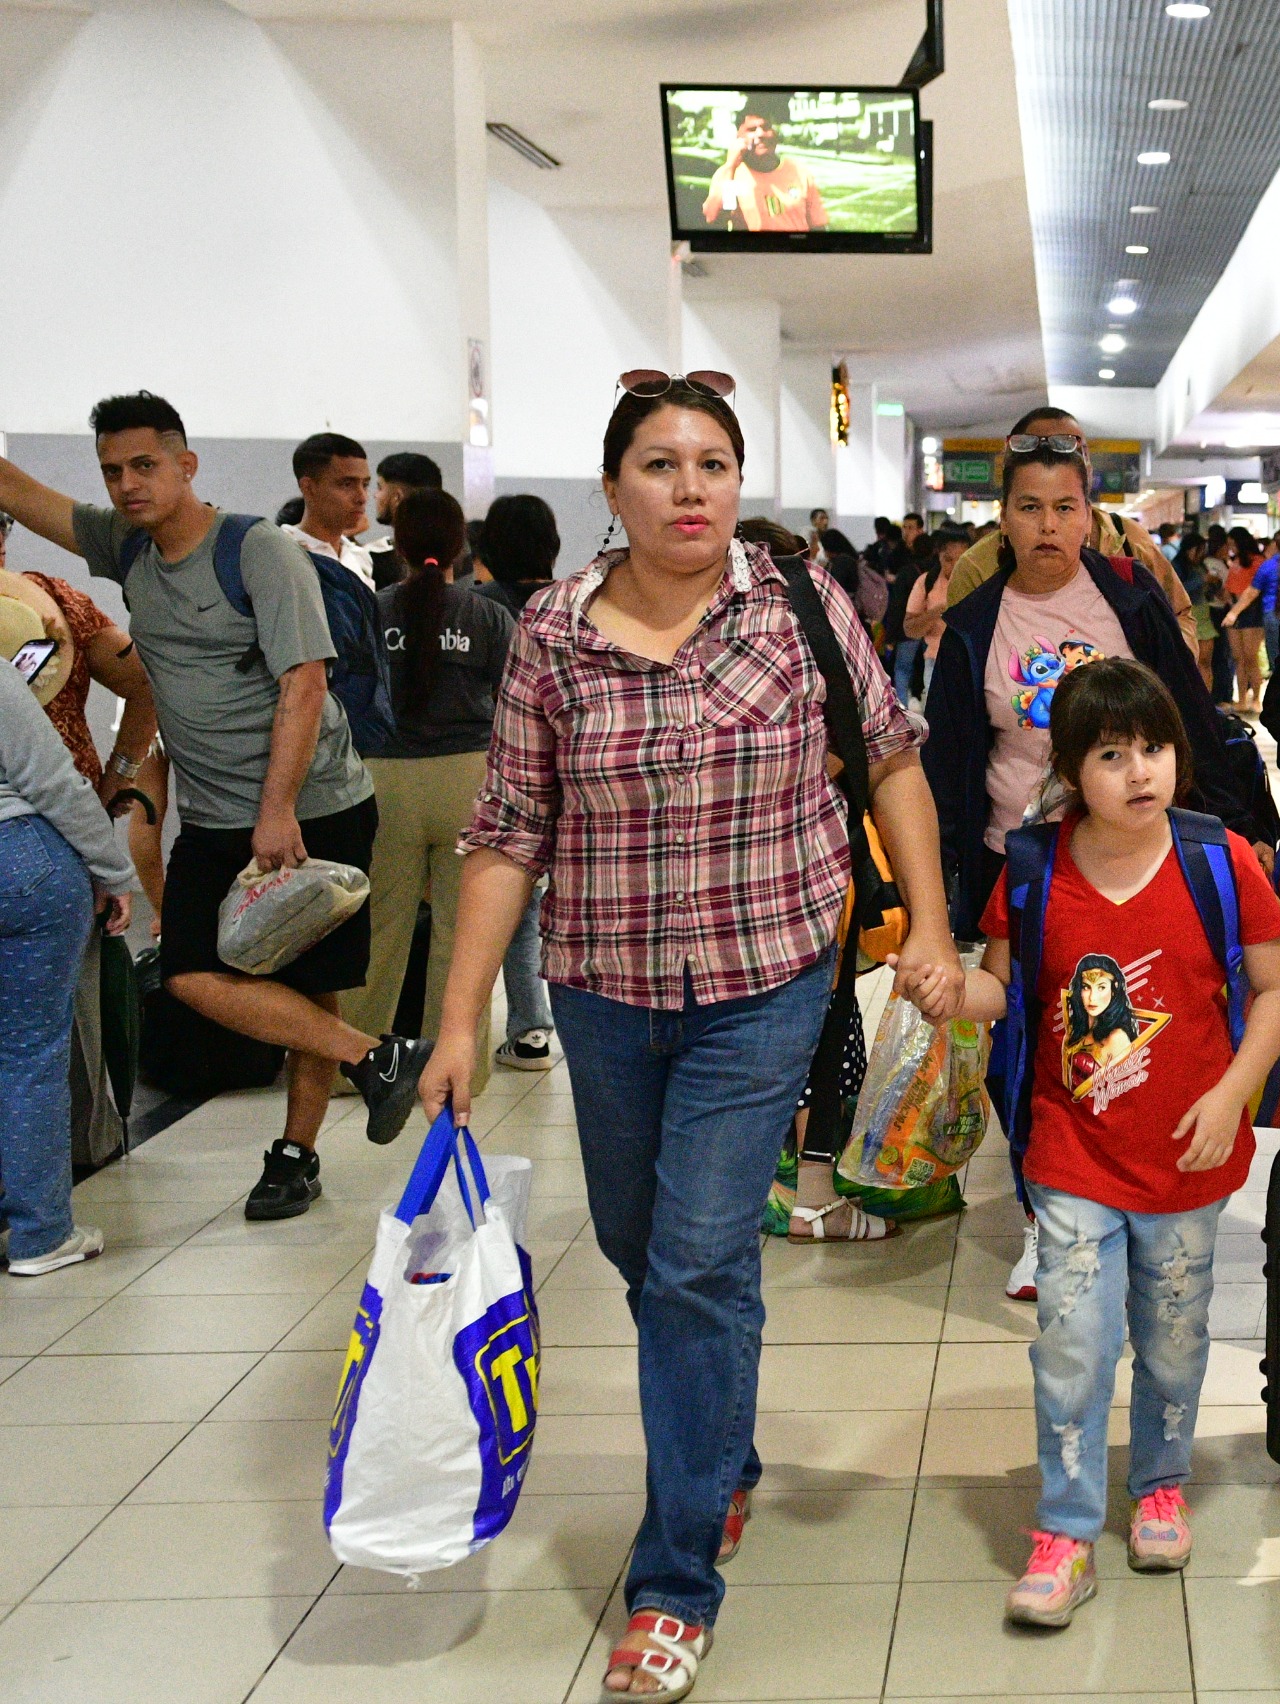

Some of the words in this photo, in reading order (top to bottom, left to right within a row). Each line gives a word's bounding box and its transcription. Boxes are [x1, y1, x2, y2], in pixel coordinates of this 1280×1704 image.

[384, 627, 471, 653] Cbia
[1093, 1044, 1151, 1088] Wonder
[1088, 1069, 1150, 1115] Woman
